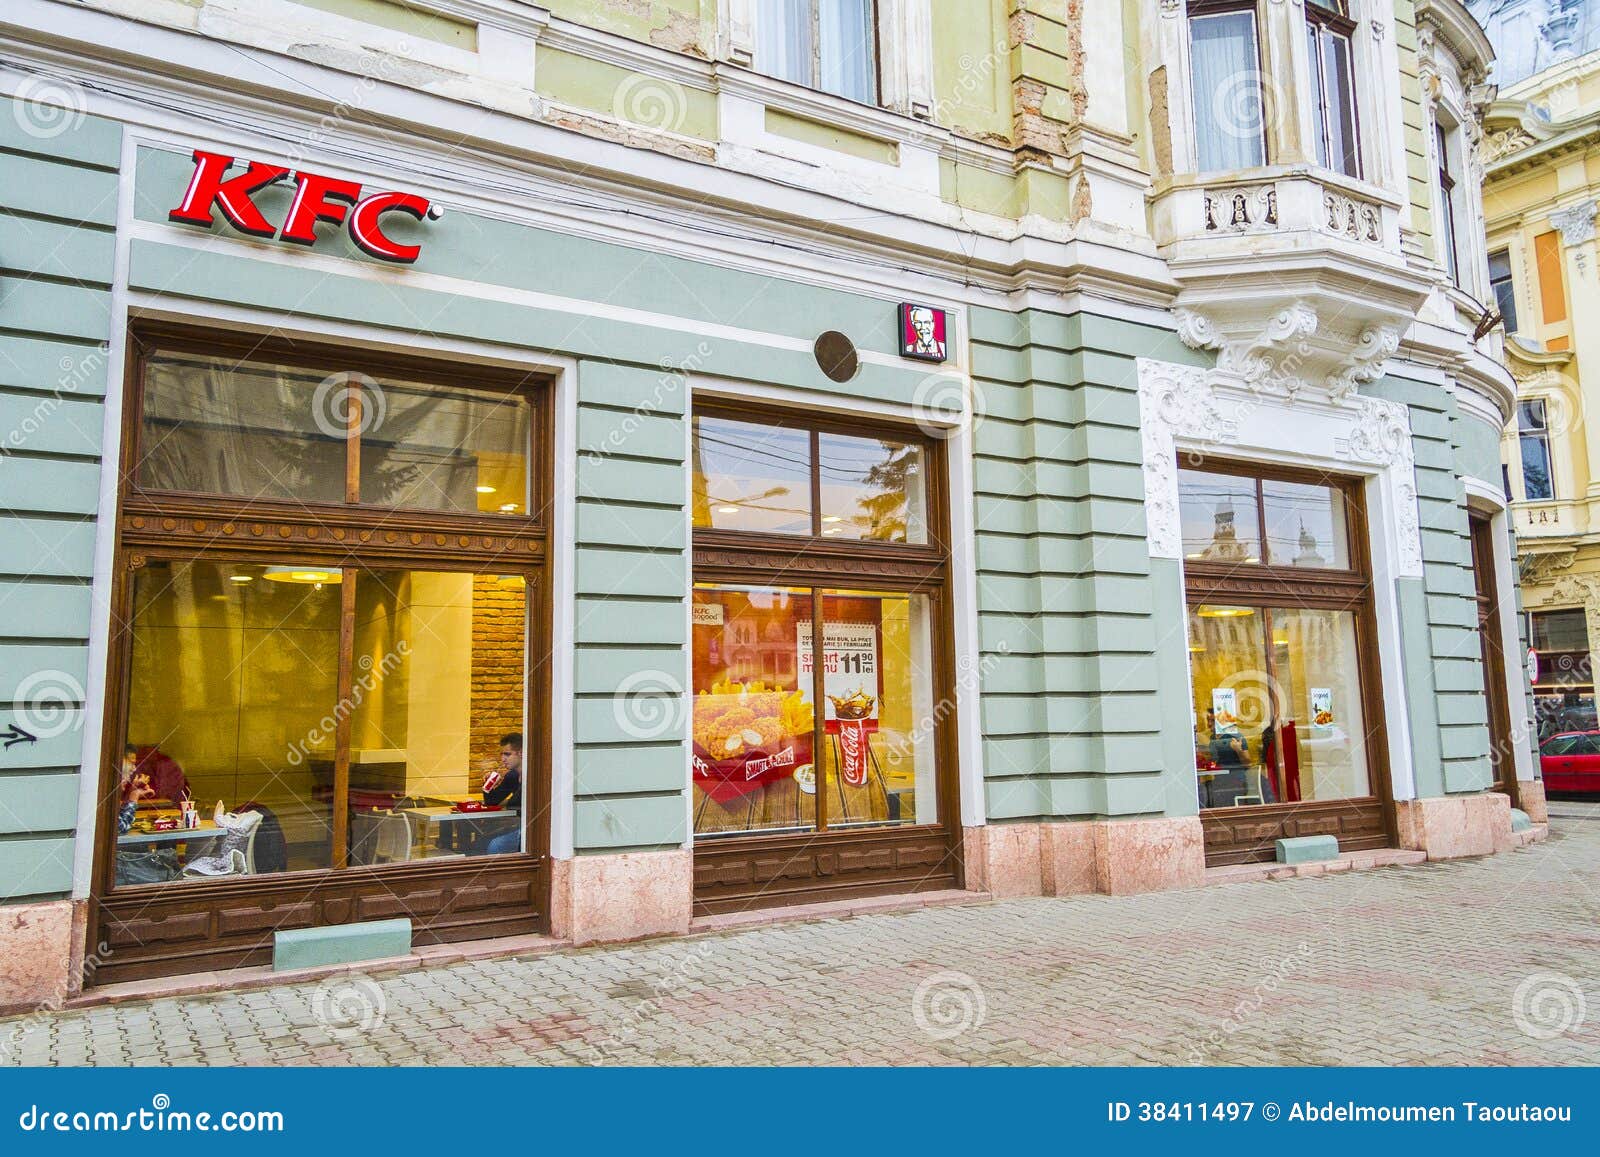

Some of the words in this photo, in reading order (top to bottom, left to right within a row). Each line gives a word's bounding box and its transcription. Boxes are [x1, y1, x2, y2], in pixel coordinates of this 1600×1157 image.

[168, 149, 430, 264] KFC
[802, 663, 838, 673] mnu
[840, 652, 861, 674] 11
[861, 652, 874, 661] 90
[862, 665, 874, 674] lei
